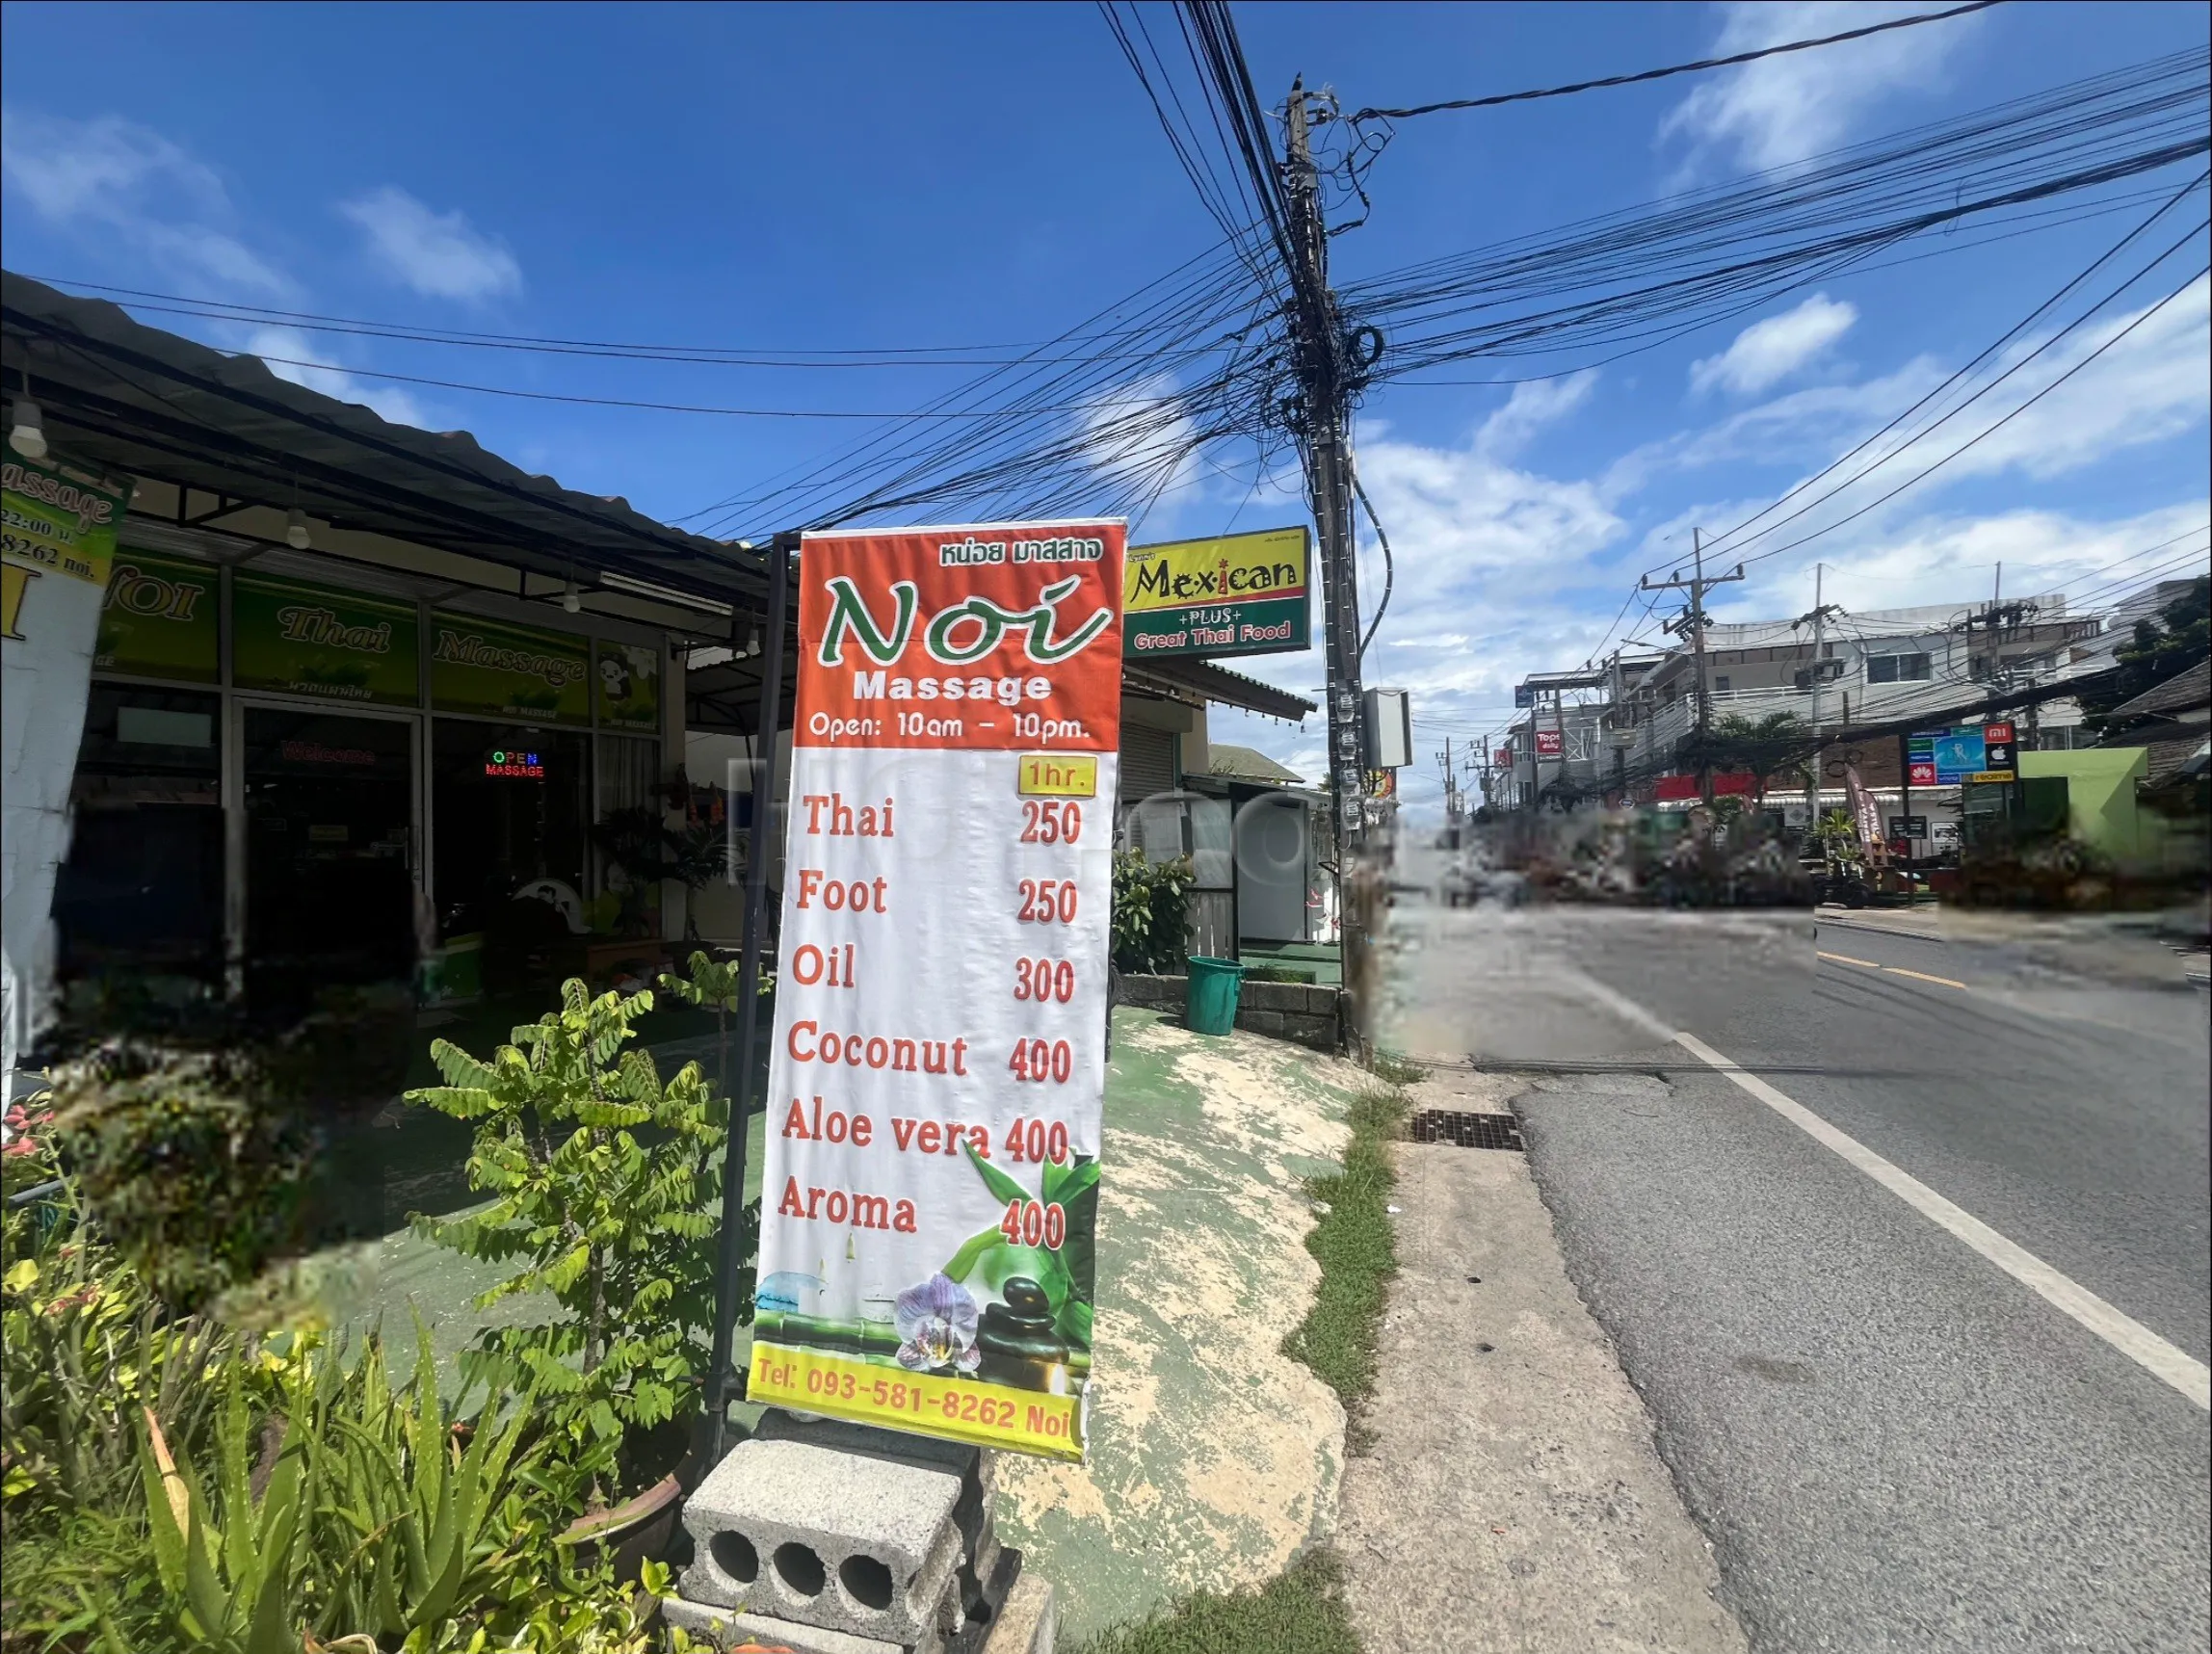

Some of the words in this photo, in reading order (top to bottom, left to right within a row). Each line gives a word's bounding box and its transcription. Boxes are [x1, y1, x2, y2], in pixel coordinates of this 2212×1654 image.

[939, 537, 1005, 566] หน่อย
[1130, 559, 1297, 602] Mexican
[819, 574, 1114, 667] Noi
[1135, 631, 1187, 649] Great
[1192, 623, 1234, 645] Thai
[1241, 620, 1291, 642] Food
[276, 607, 391, 654] Thai
[432, 630, 586, 687] Massage
[853, 670, 1051, 706] Massage
[809, 712, 882, 744] Open:
[897, 712, 962, 736] 10am
[1014, 713, 1090, 745] 10pm.
[281, 740, 376, 766] Welcome
[486, 763, 544, 778] MASSAGE
[492, 750, 538, 765] OPEN
[1029, 760, 1085, 787] 1hr.
[803, 792, 895, 837] Thai
[1020, 801, 1081, 844] 250
[797, 869, 887, 913] Foot
[1017, 879, 1078, 924] 250
[792, 943, 856, 988] Oil
[1014, 957, 1074, 1003] 300
[787, 1019, 968, 1077] Coconut
[1009, 1037, 1071, 1084] 400
[781, 1095, 872, 1146] Aloe
[891, 1117, 990, 1159] vera
[1005, 1117, 1068, 1165] 400
[777, 1174, 917, 1233] Aroma
[1000, 1198, 1066, 1249] 400
[807, 1368, 1016, 1430] 093-581-8262
[1026, 1404, 1070, 1438] Noi
